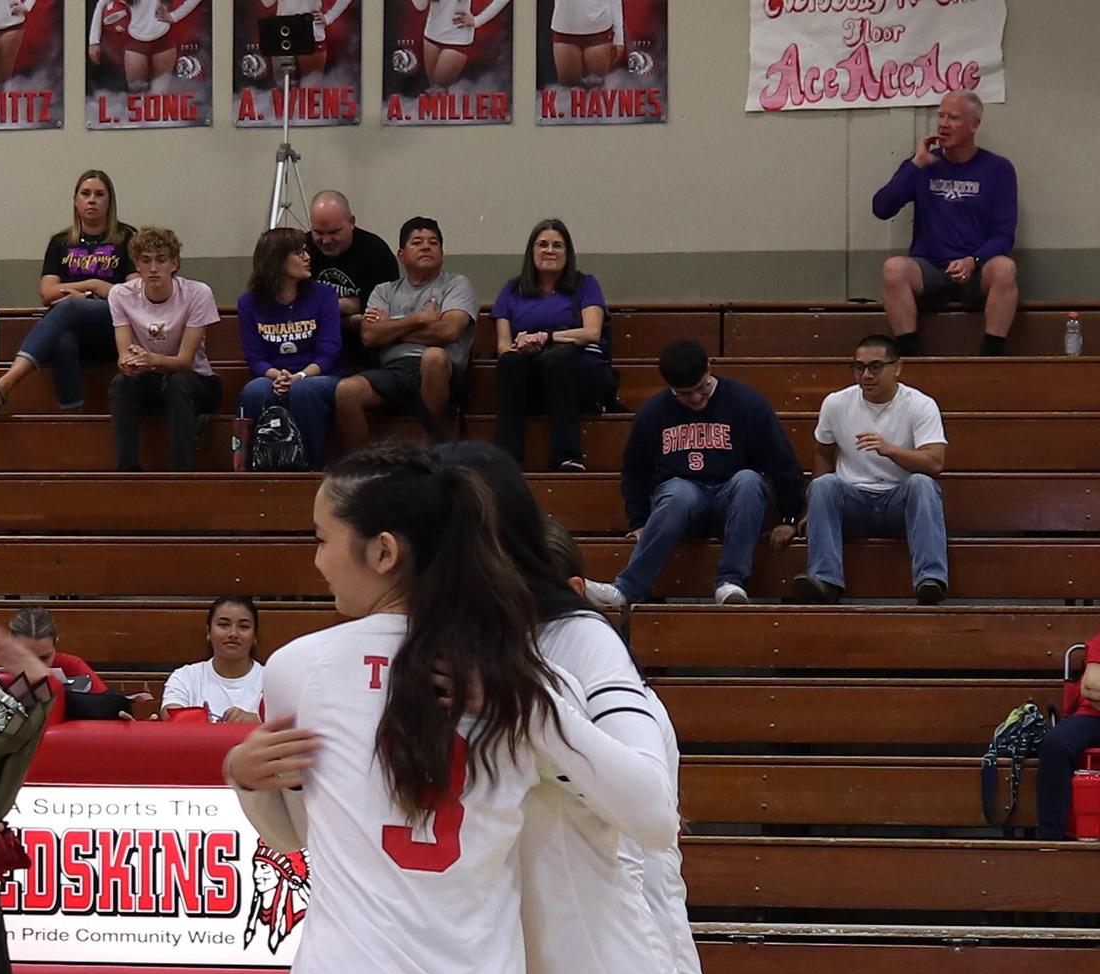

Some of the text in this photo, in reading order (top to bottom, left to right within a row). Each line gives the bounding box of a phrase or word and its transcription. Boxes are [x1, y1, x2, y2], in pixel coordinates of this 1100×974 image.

[98, 93, 197, 123] L. SONG
[238, 86, 357, 120] A. VIENS
[387, 92, 508, 120] A. MILLER
[541, 87, 662, 118] K. HAYNES
[257, 319, 316, 334] MINARETS
[262, 331, 312, 342] MUSTANGS
[662, 423, 732, 454] SYRACUSE
[688, 452, 704, 470] S
[34, 799, 158, 818] Supports
[169, 800, 219, 816] The
[22, 928, 69, 941] Pride
[76, 929, 181, 946] Community
[187, 931, 235, 944] Wide
